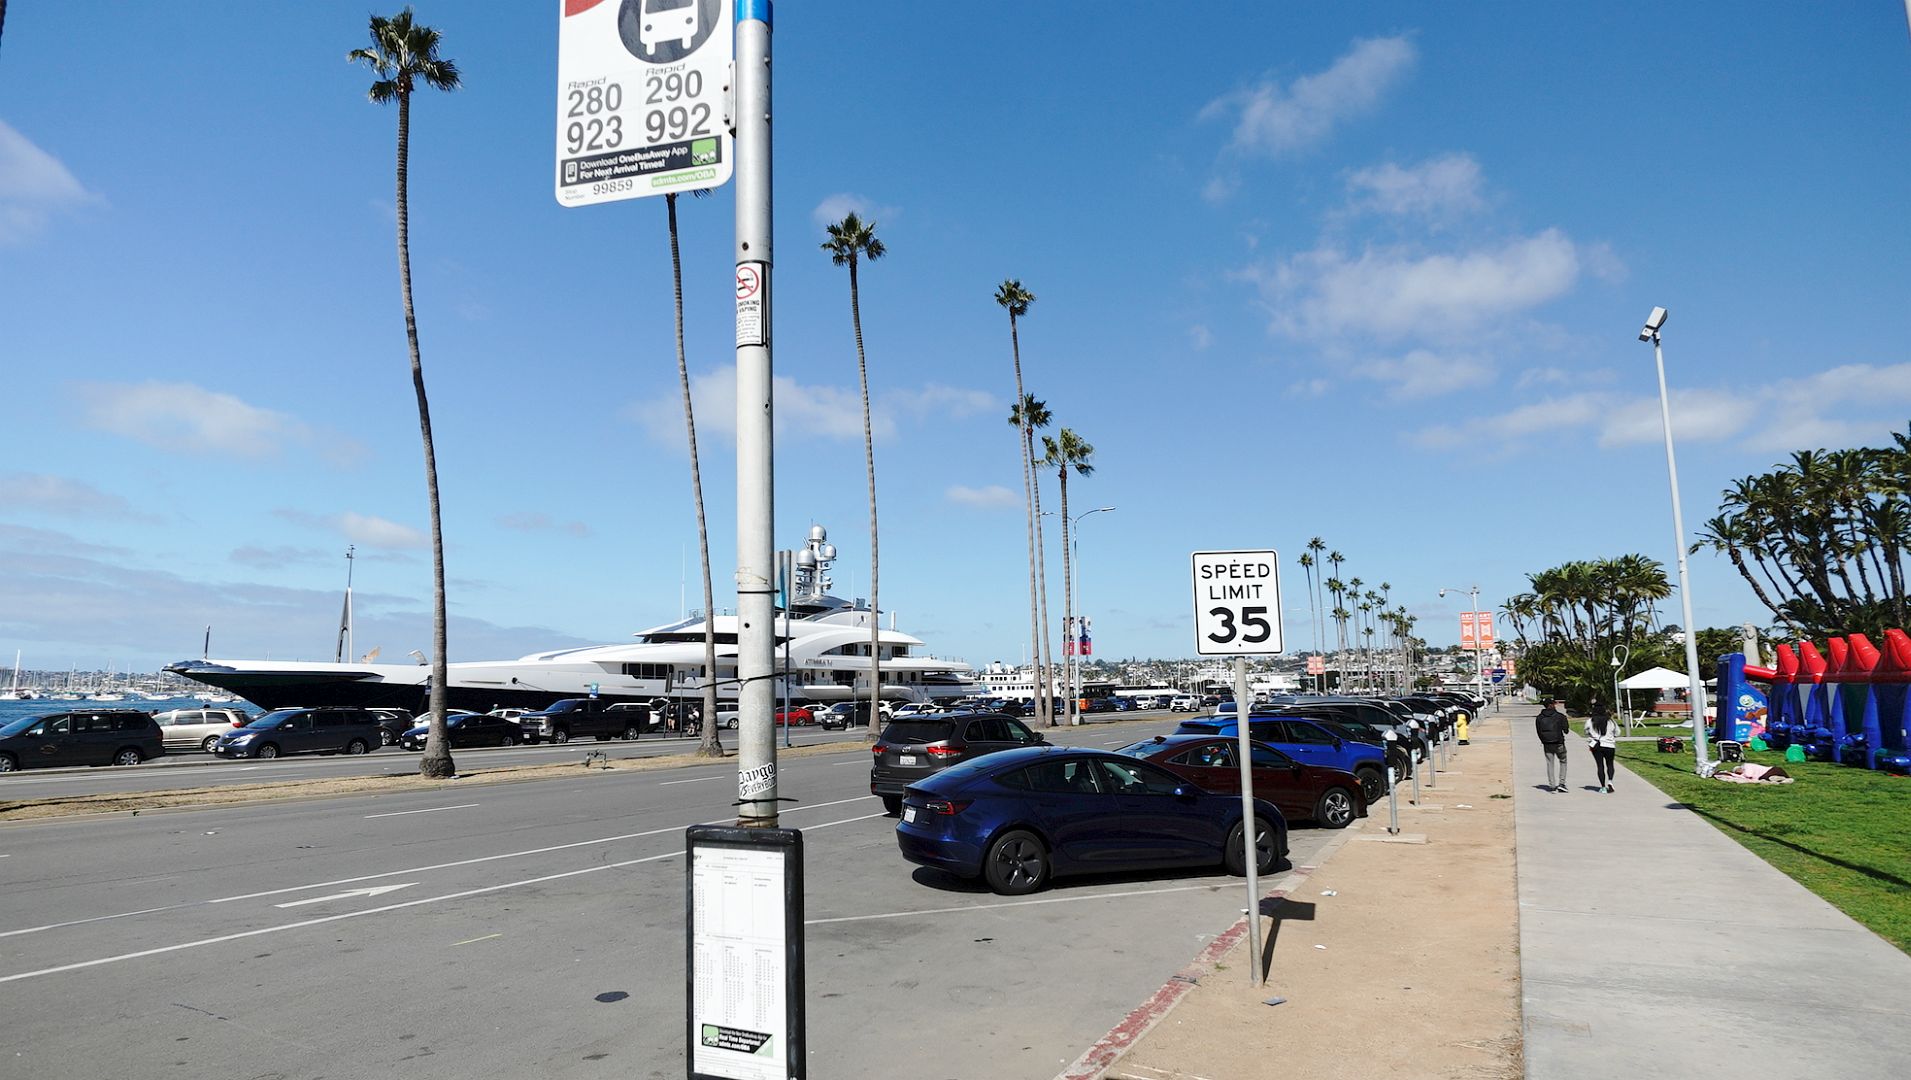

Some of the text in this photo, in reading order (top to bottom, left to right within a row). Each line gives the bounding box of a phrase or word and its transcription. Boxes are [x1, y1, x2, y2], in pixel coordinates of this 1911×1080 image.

[645, 63, 686, 77] Rapid
[567, 76, 607, 90] Rapid
[645, 69, 703, 105] 290
[567, 83, 623, 118] 280
[645, 102, 711, 143] 992
[566, 115, 623, 154] 923
[580, 146, 688, 170] Download OneBusAway App
[580, 159, 666, 180] For Next Arrival Times!
[593, 179, 633, 196] 99859
[1201, 563, 1270, 579] SPEED
[1209, 584, 1263, 600] LIMIT
[1207, 606, 1271, 644] 35
